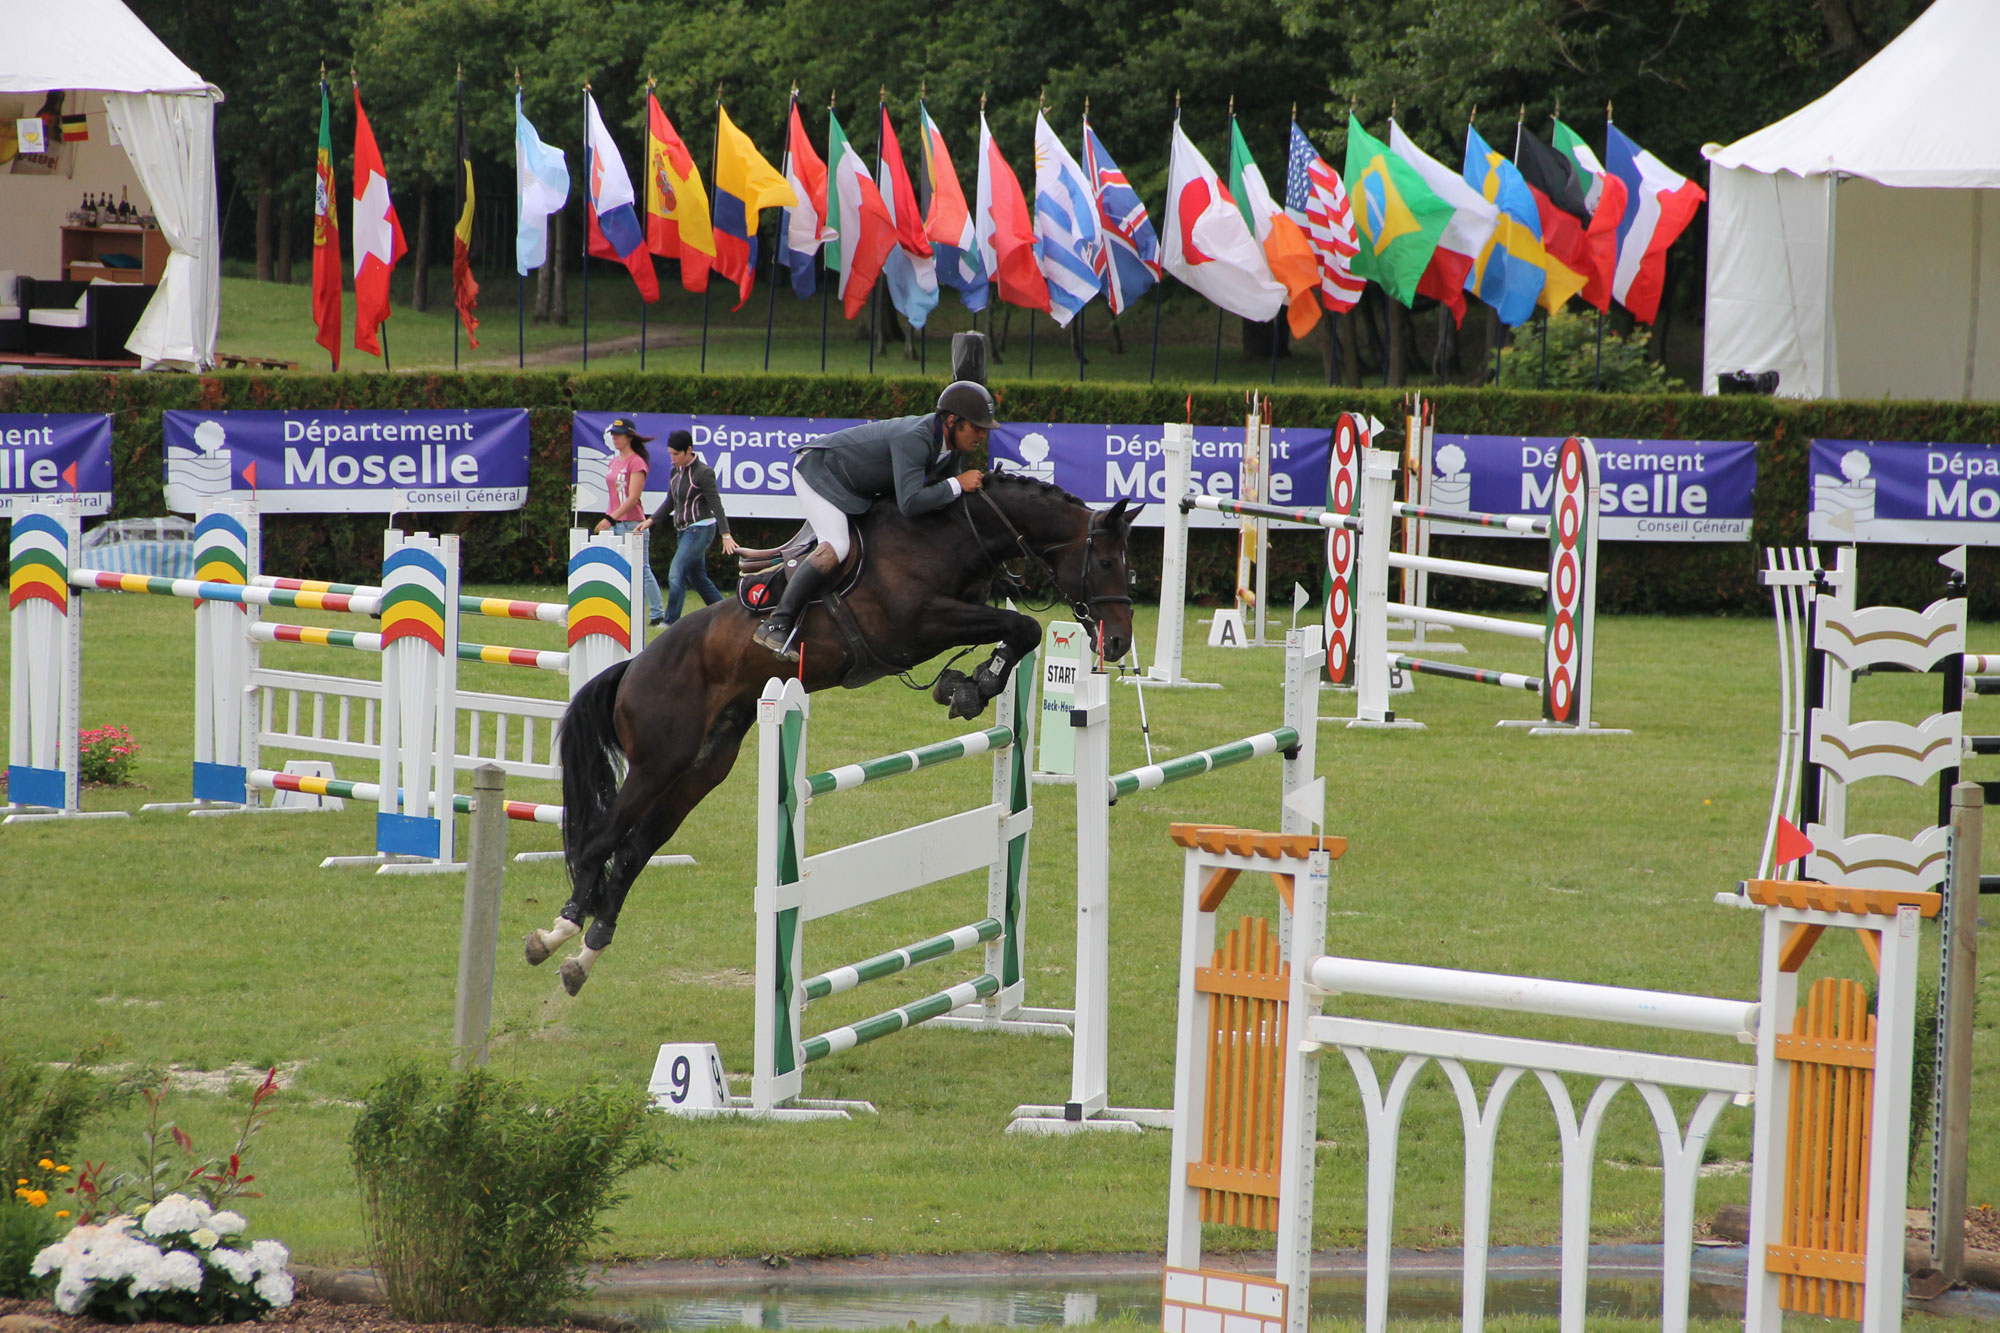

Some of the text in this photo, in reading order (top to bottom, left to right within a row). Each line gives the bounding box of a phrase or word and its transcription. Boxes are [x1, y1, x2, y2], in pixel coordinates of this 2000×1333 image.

[0, 427, 53, 446] ent
[284, 419, 474, 446] Département
[284, 444, 479, 485] Moselle
[693, 451, 791, 491] Mos
[1522, 446, 1705, 472] Dértement
[406, 489, 520, 503] Conseil Général
[1521, 472, 1708, 515] Mselle
[1637, 519, 1745, 533] Conseil Général
[1220, 619, 1237, 646] A
[1047, 664, 1077, 685] START
[1389, 666, 1403, 689] B
[670, 1055, 690, 1104] 9
[711, 1054, 725, 1102] 9
